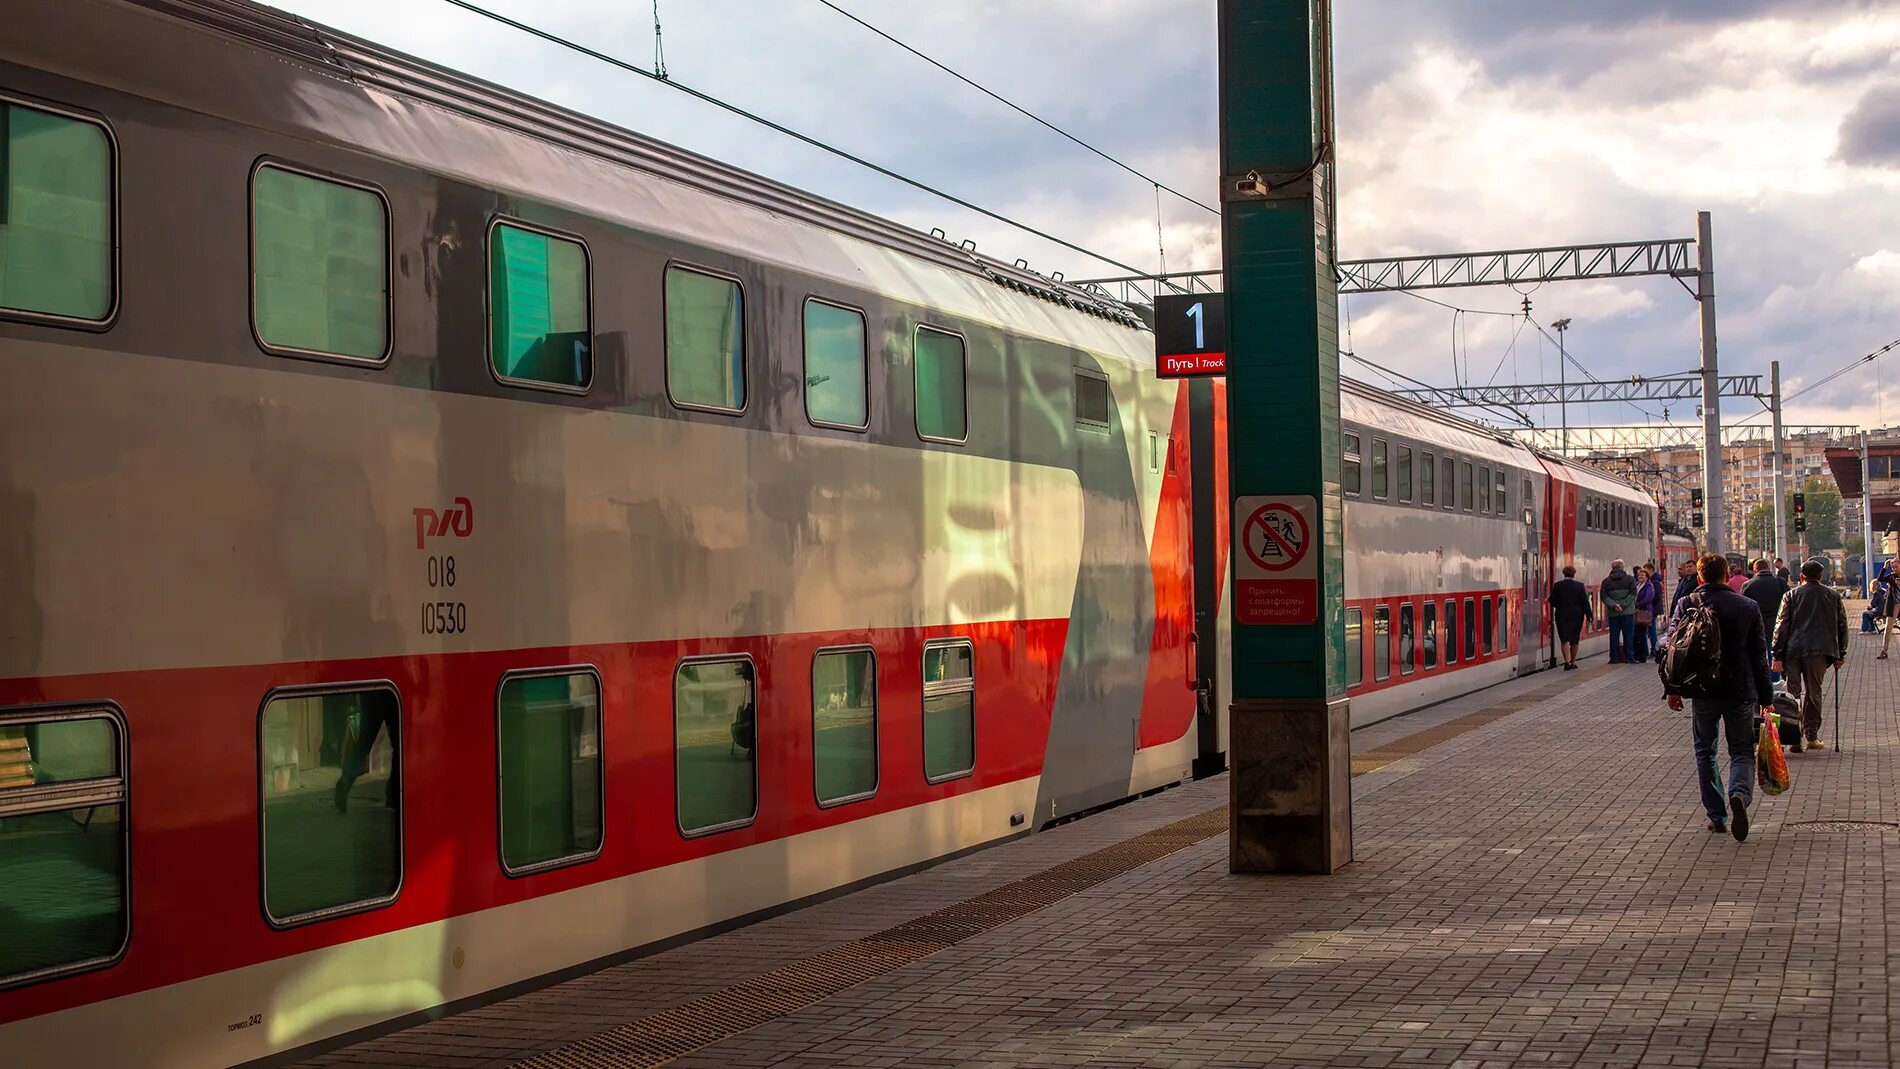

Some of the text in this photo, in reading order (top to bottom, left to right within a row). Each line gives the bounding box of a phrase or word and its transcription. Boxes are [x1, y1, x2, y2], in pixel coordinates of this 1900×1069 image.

[1186, 302, 1204, 349] 1
[1167, 358, 1225, 372] Путь Track
[428, 555, 456, 588] 018
[1248, 586, 1285, 597] Прыгать
[1254, 598, 1305, 607] платформы
[421, 602, 467, 635] 10530
[248, 1013, 262, 1027] 242
